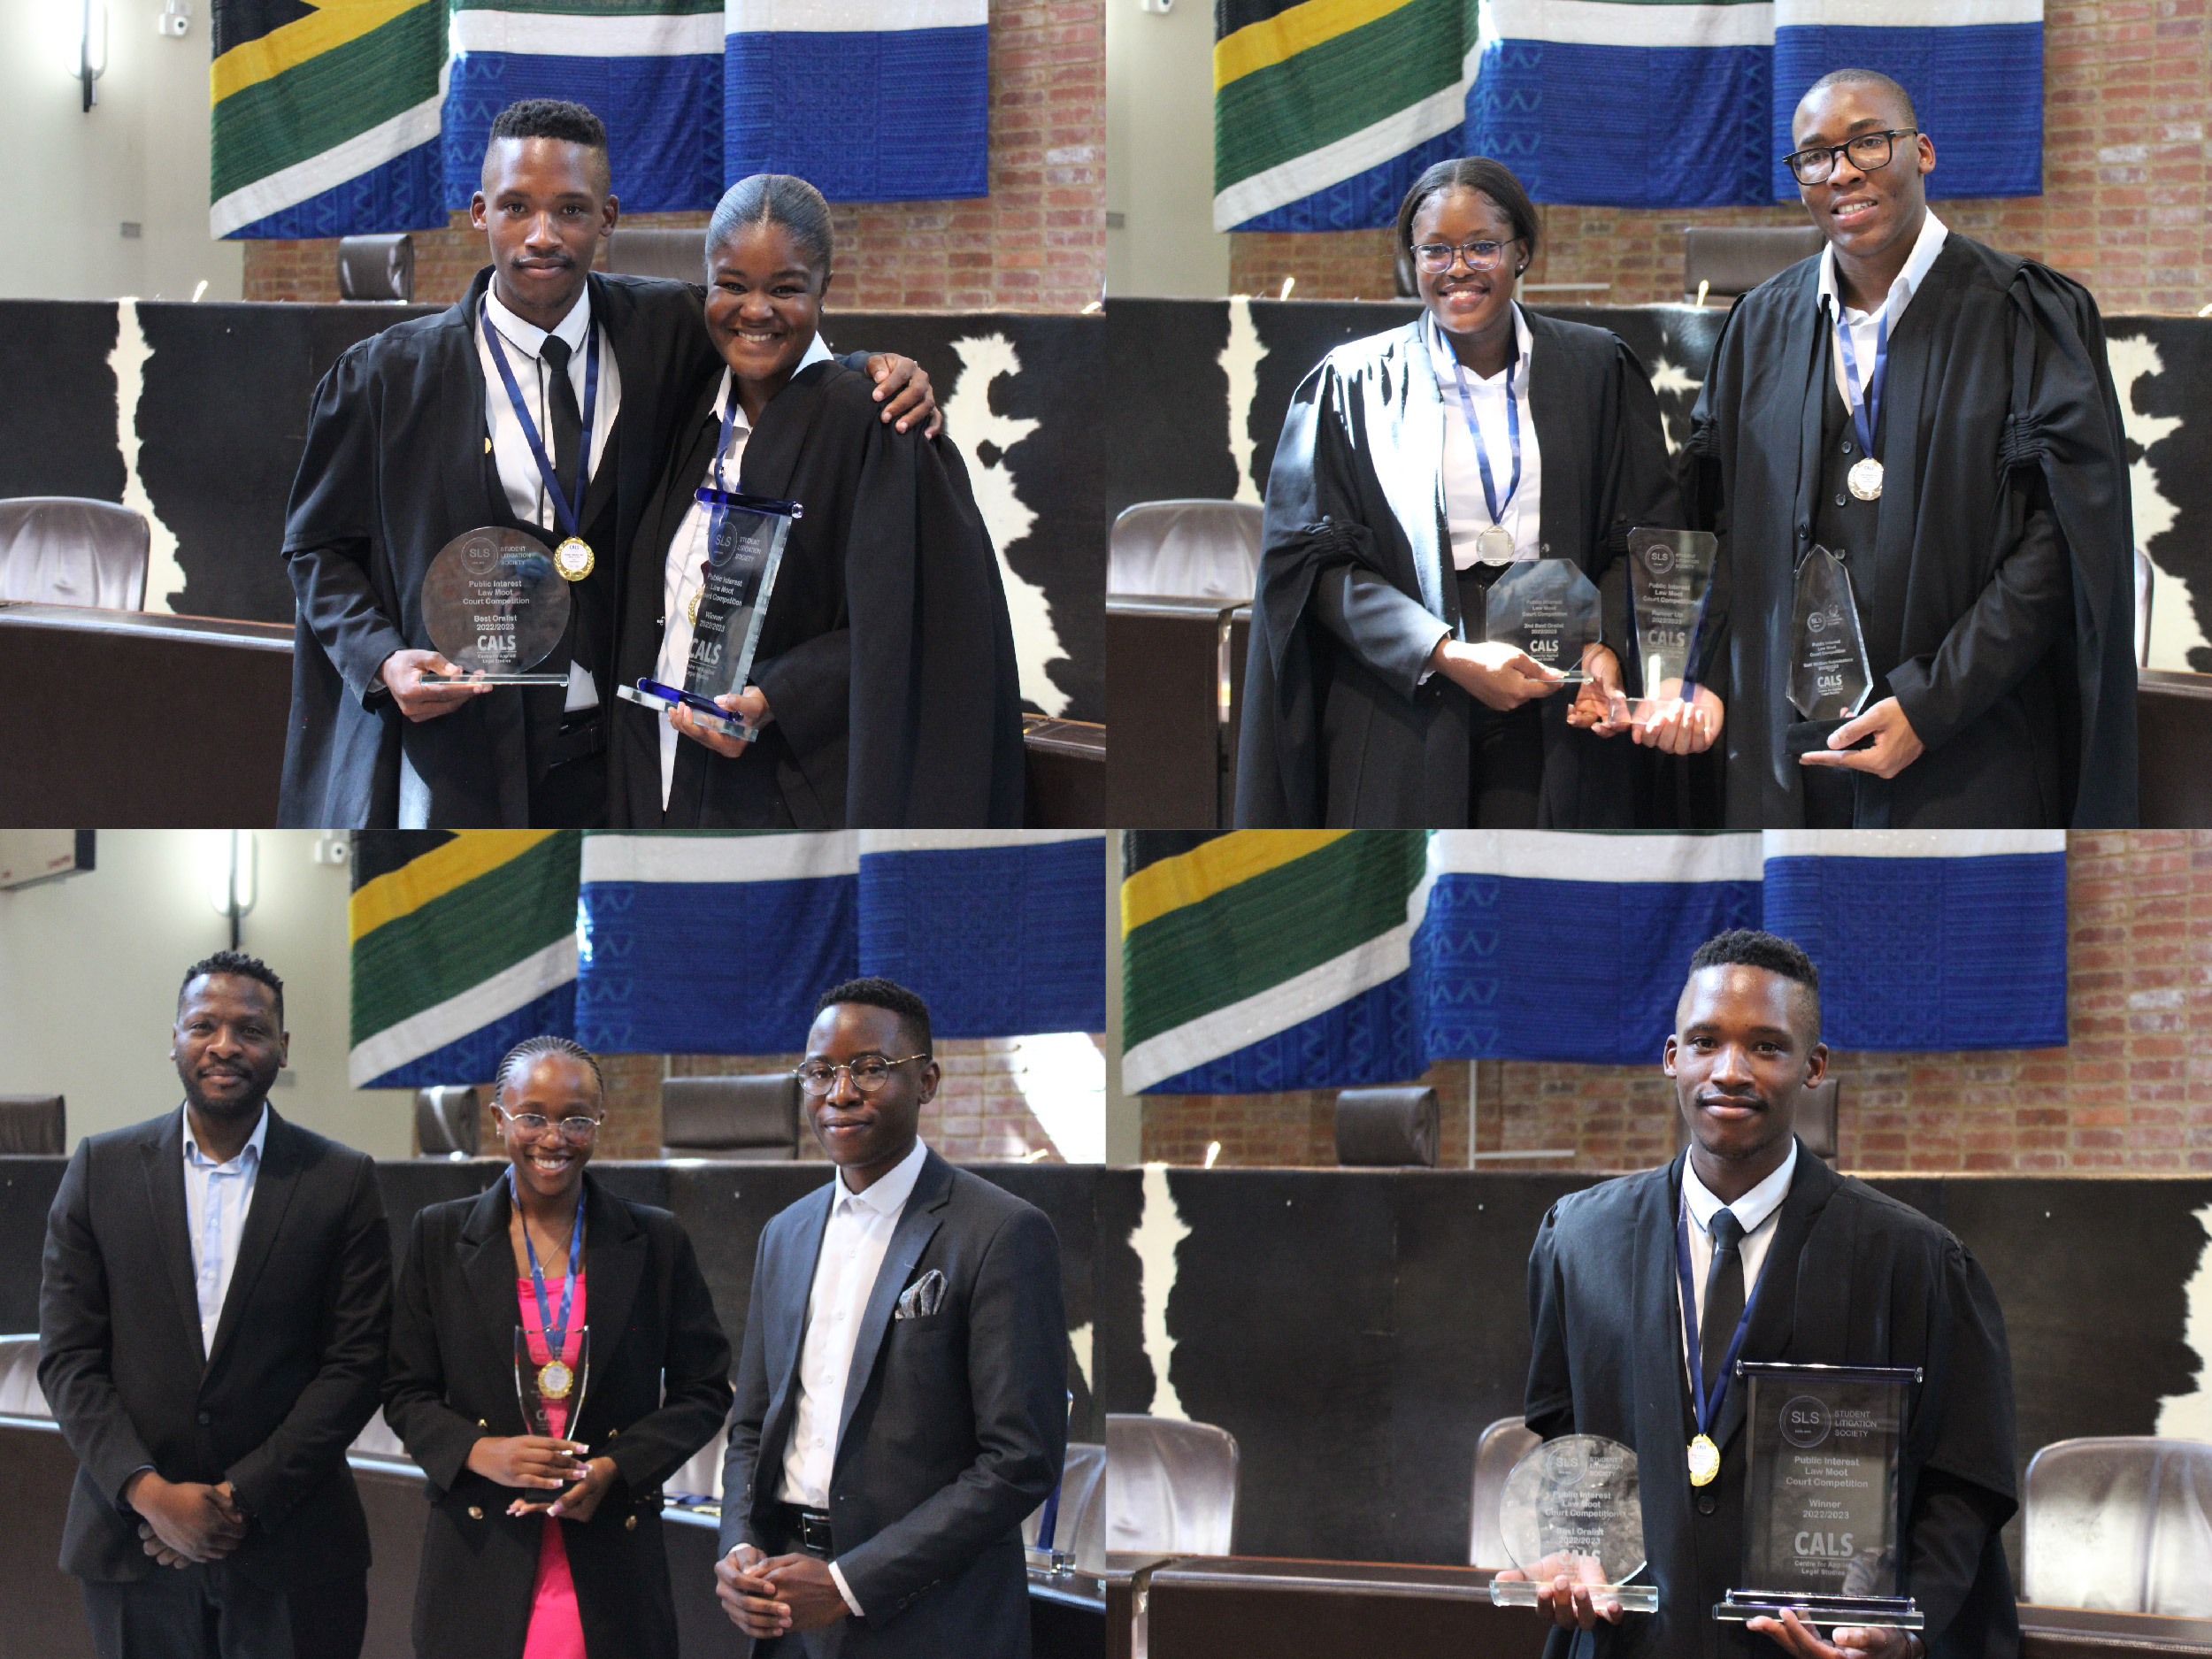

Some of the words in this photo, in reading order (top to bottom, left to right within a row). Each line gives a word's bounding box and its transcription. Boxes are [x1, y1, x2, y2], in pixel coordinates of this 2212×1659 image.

[715, 534, 732, 547] SLS
[739, 536, 761, 546] STUDENT
[469, 548, 490, 558] SLS
[734, 553, 756, 563] SOCIETY
[1651, 552, 1668, 561] SLS
[707, 572, 723, 582] Public
[723, 576, 743, 588] Interest
[720, 587, 734, 595] Moot
[485, 597, 530, 606] Competition
[712, 594, 742, 606] Competition
[705, 611, 724, 622] Winner
[699, 619, 726, 633] 2022/2023
[477, 634, 517, 651] CALS
[1647, 629, 1686, 648] CALS
[688, 637, 722, 665] CALS
[1530, 640, 1559, 652] CALS
[1817, 674, 1842, 687] CALS
[1791, 1410, 1820, 1425] SLS
[1834, 1419, 1878, 1428] LITIGATION
[1555, 1457, 1578, 1468] SLS
[1794, 1455, 1823, 1464] Public
[1824, 1456, 1860, 1466] Interest
[1805, 1466, 1824, 1475] Law
[1825, 1467, 1848, 1477] Moot
[1786, 1476, 1811, 1486] Court
[1813, 1478, 1869, 1489] Competition
[1579, 1491, 1611, 1500] Interest
[1808, 1498, 1842, 1509] Winner
[1570, 1509, 1619, 1518] Competition
[1802, 1509, 1849, 1519] 2022/2023
[1577, 1526, 1604, 1536] Oralist
[1794, 1531, 1854, 1557] CALS
[1557, 1548, 1601, 1566] CALS
